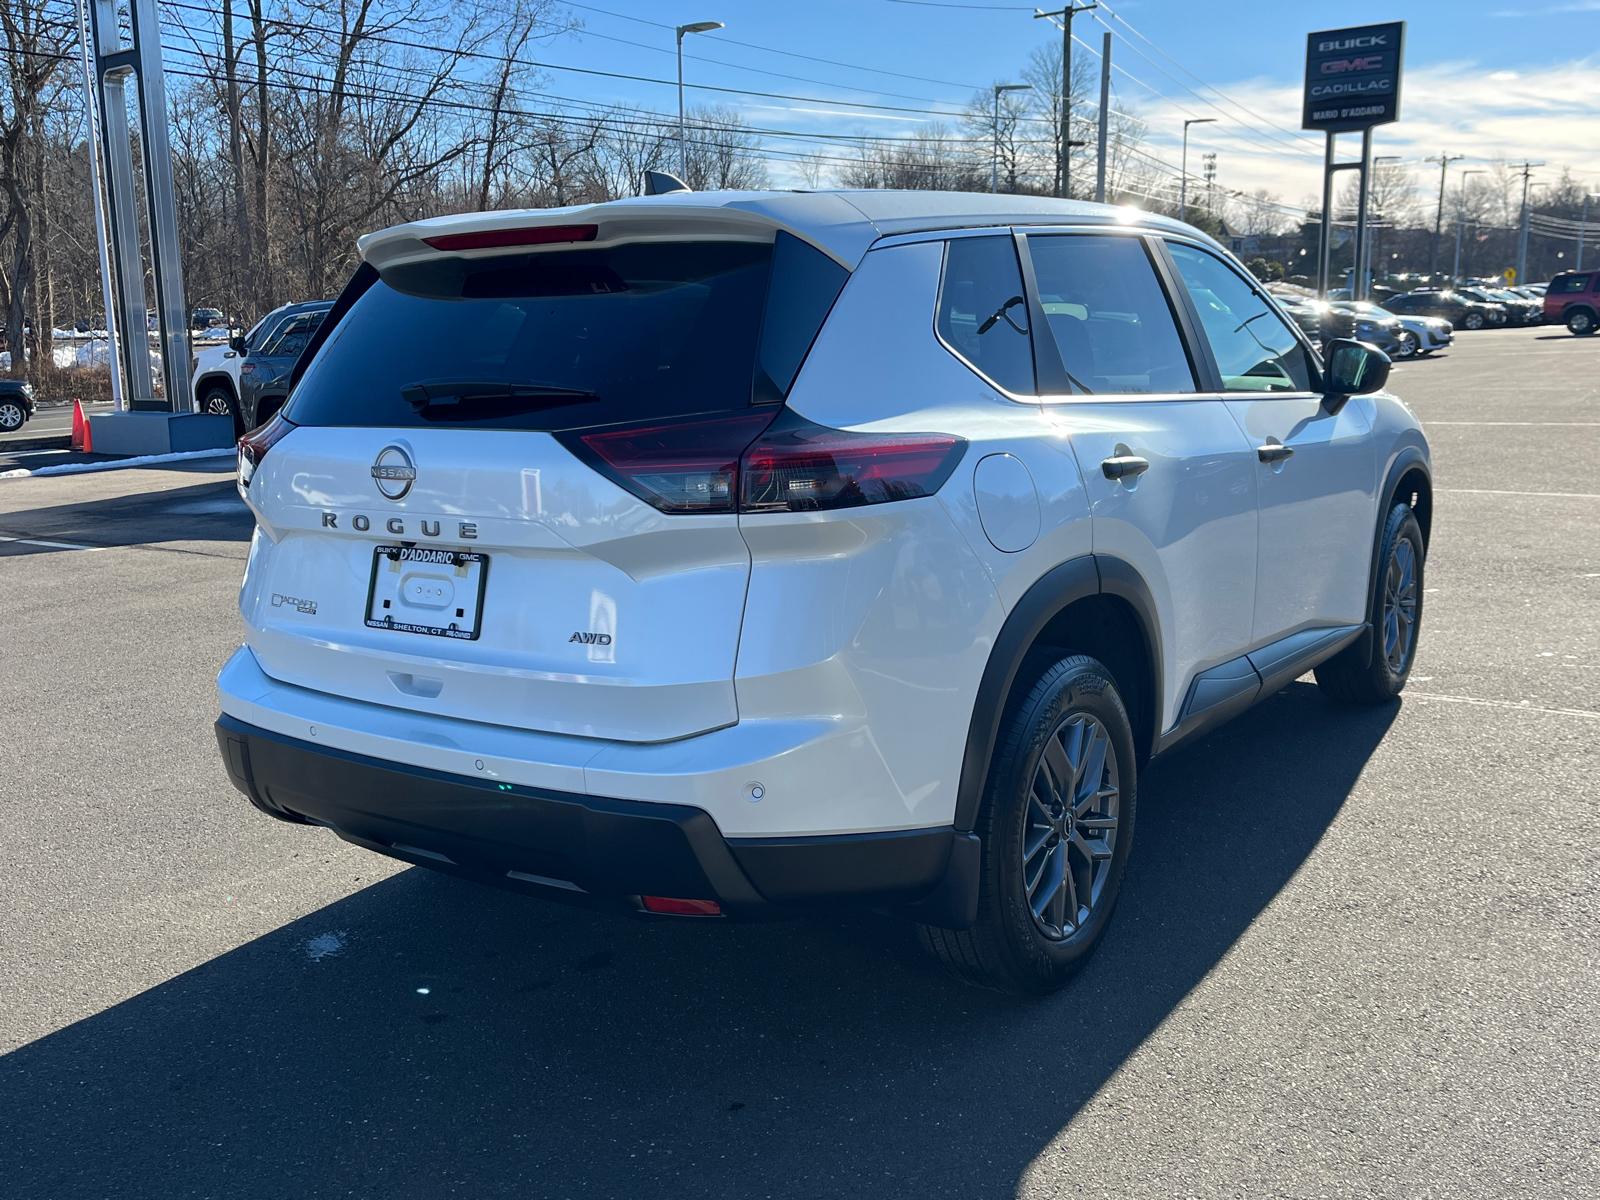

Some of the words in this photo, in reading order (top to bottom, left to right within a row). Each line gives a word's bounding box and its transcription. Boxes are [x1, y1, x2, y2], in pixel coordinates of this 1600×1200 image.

[1319, 35, 1387, 52] BUICK
[1321, 56, 1383, 74] GMC
[1311, 79, 1390, 95] CADILLAC
[1313, 109, 1338, 120] MARIO
[1341, 105, 1385, 118] D'ADDARIO
[371, 468, 415, 479] NISSAN
[322, 512, 478, 539] ROGUE
[400, 548, 454, 564] D'ADDARIO
[460, 553, 479, 561] GMC
[367, 620, 388, 628] NISSAN
[393, 623, 429, 634] SHELTON,
[568, 631, 612, 646] AWD
